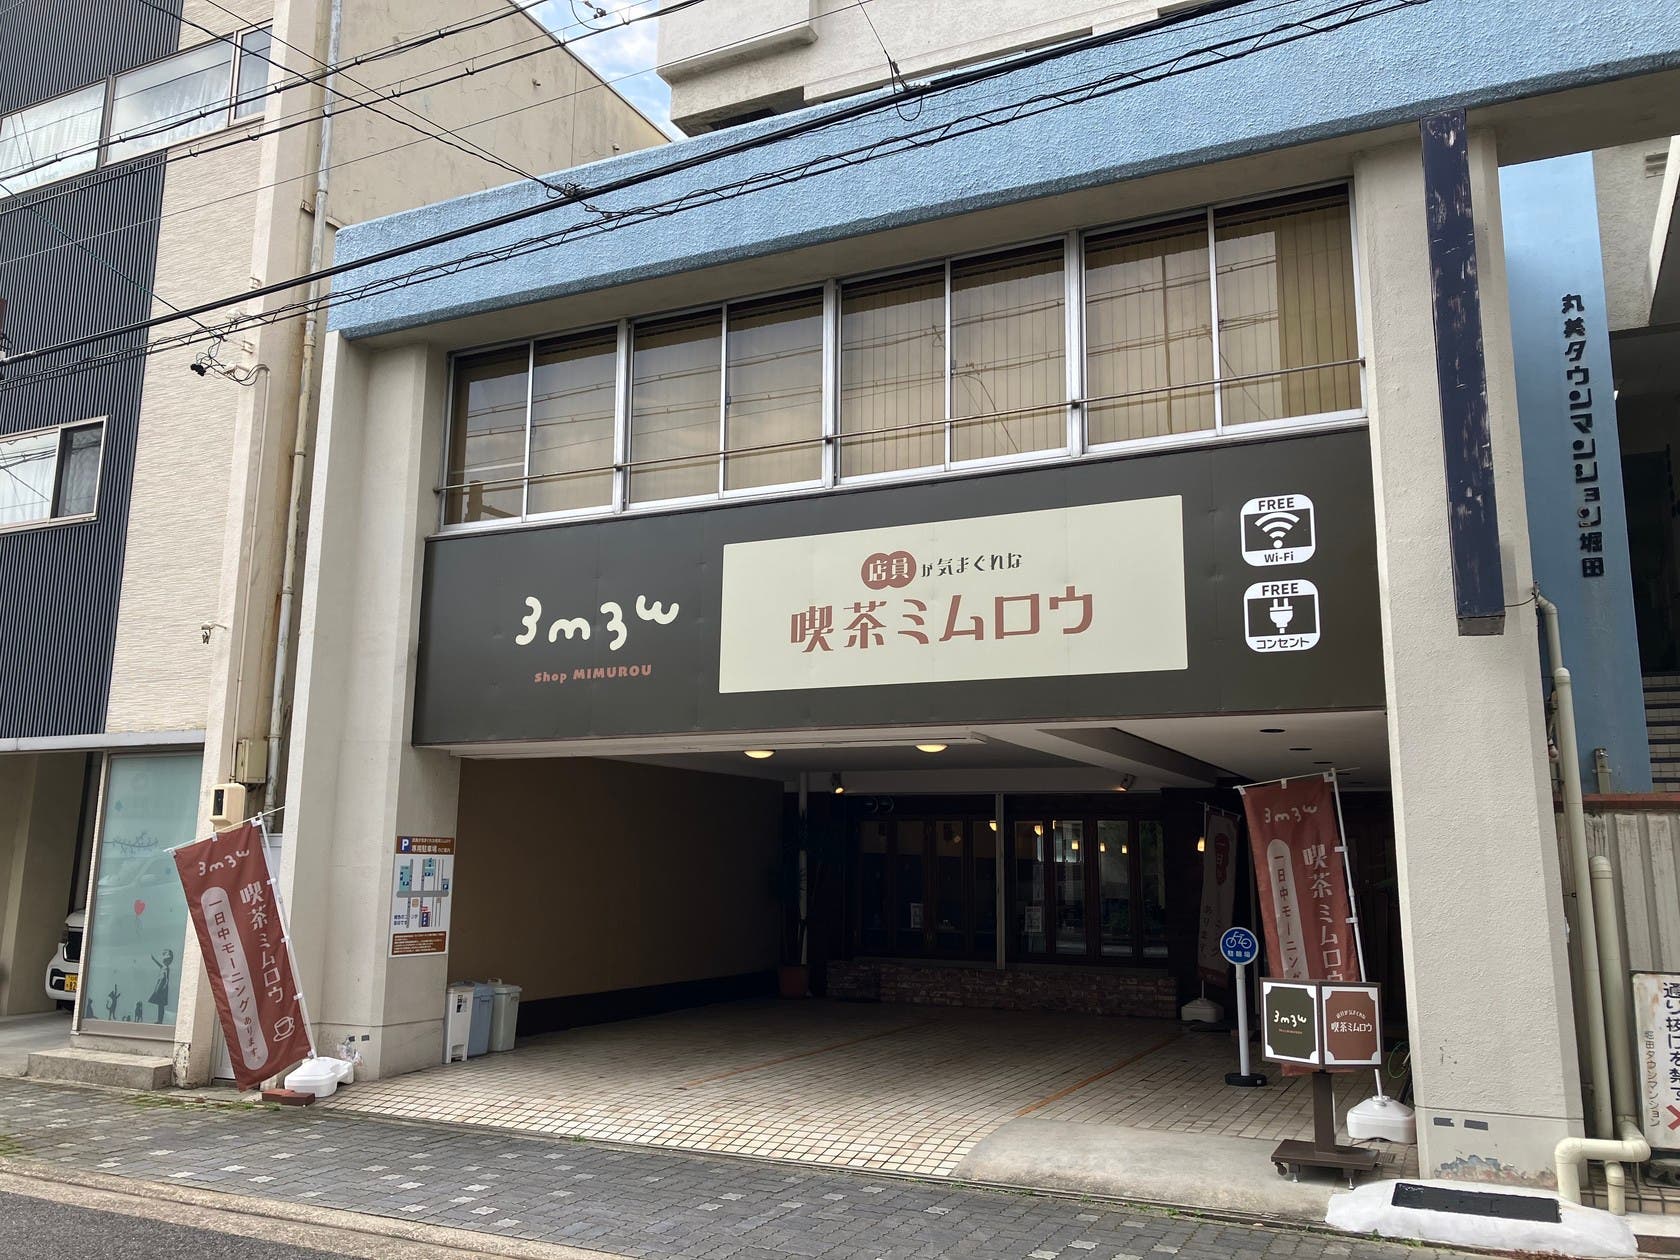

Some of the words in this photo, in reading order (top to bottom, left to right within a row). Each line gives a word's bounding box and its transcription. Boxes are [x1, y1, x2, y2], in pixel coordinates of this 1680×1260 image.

[1258, 497, 1295, 511] FREE
[1264, 551, 1294, 563] Wi-Fi
[868, 552, 1022, 582] 店員が気まぐれな
[1262, 583, 1299, 596] FREE
[790, 585, 1094, 653] 喫茶ミムロウ
[1256, 637, 1310, 650] コンセント
[534, 671, 568, 684] Shop
[573, 664, 652, 680] MIMUROU
[401, 838, 409, 851] P
[240, 880, 284, 1003] 喫茶ミムロウ
[1331, 1021, 1373, 1033] 喫茶ミムロウ
